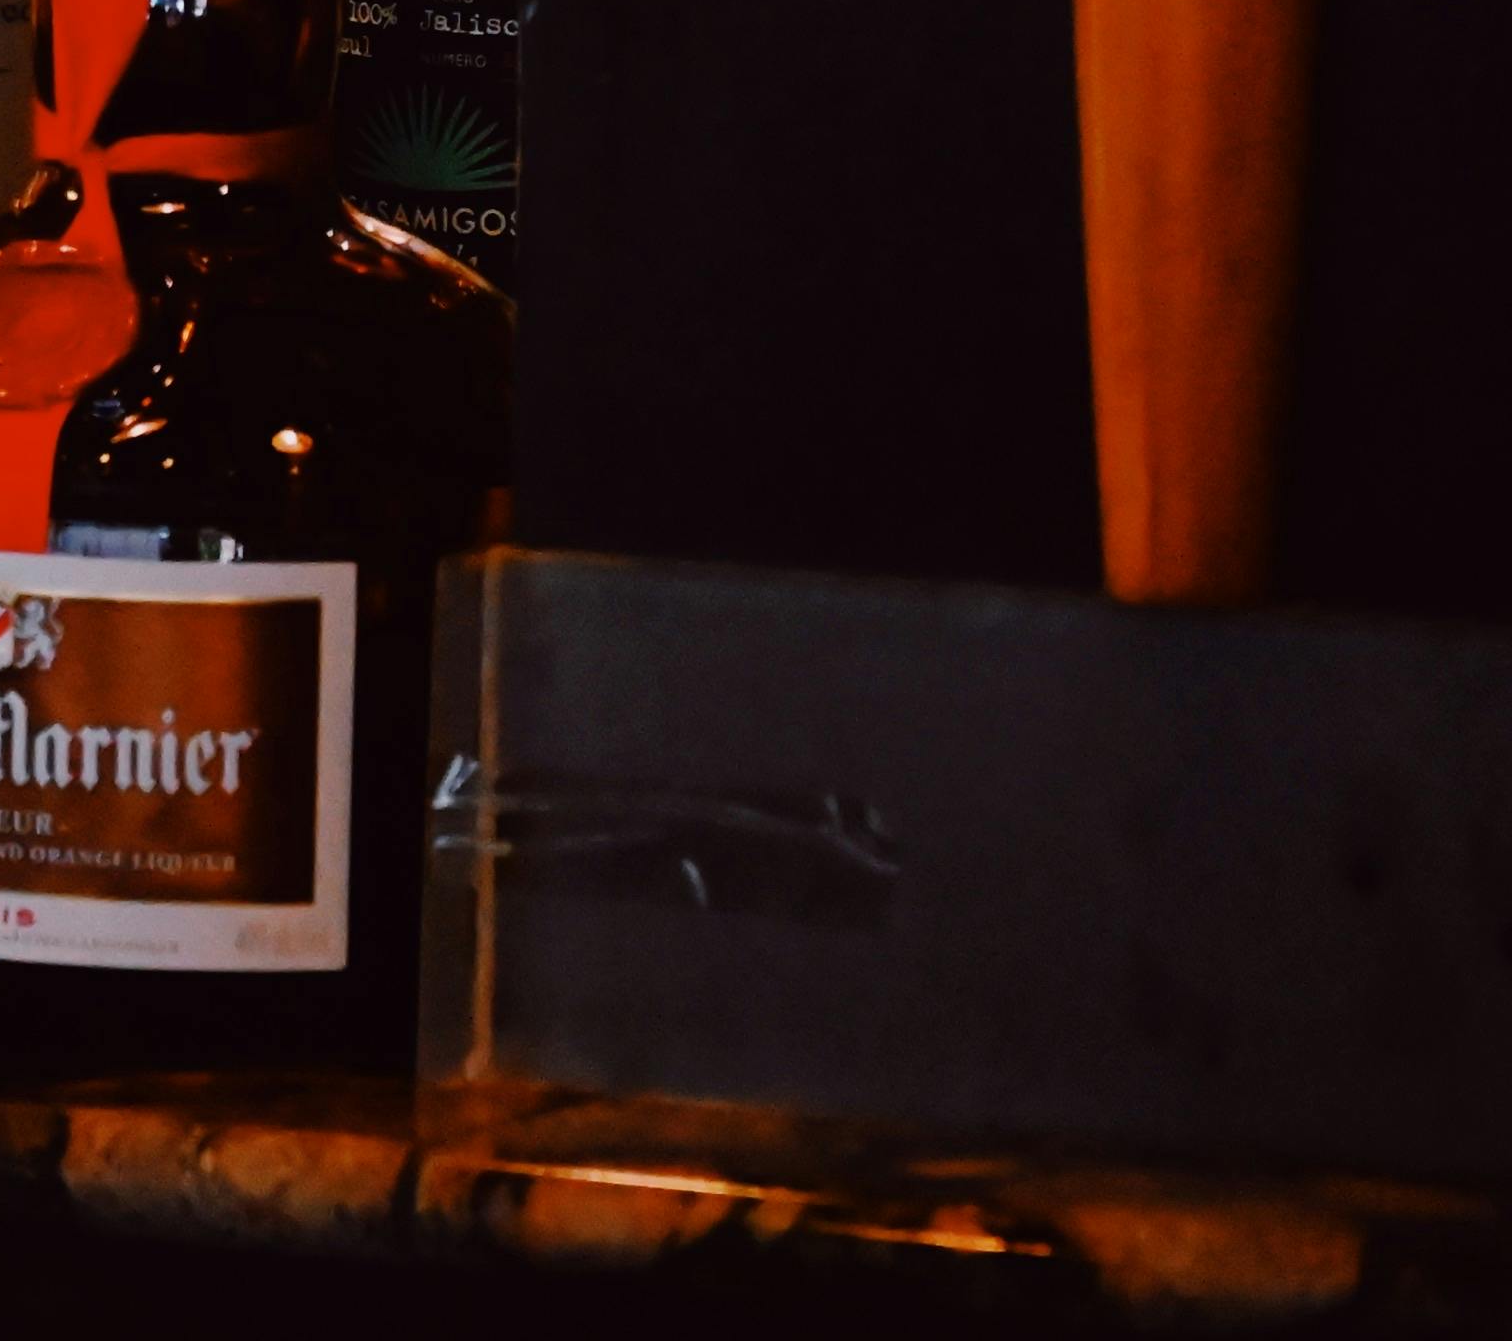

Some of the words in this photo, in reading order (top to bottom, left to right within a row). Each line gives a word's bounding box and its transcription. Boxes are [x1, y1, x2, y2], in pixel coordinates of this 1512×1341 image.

[349, 0, 397, 27] 100%
[419, 9, 519, 36] Jalisc
[340, 36, 372, 58] zul
[30, 846, 122, 869] ORANGE
